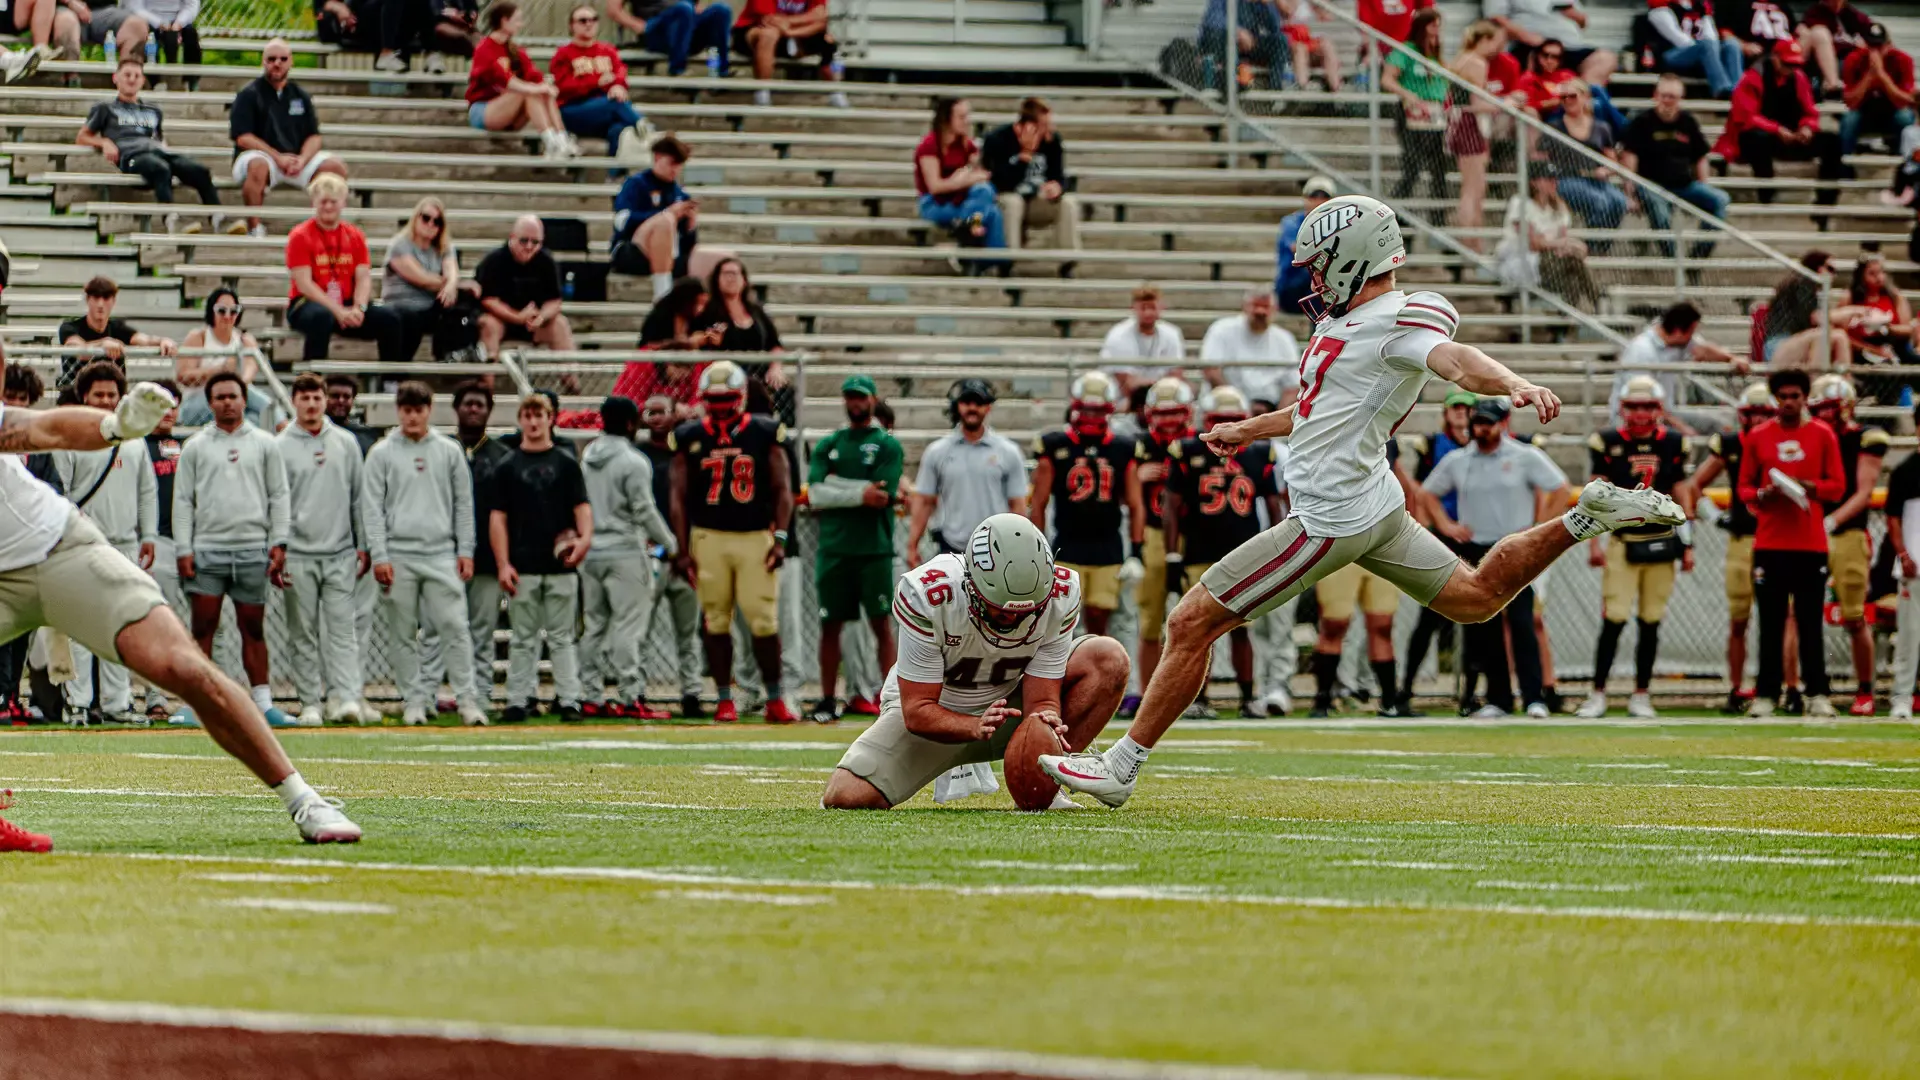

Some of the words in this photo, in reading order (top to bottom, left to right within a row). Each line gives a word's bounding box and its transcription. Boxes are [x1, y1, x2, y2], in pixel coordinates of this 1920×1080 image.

[1311, 204, 1358, 248] IUP
[702, 455, 755, 505] 78
[1066, 463, 1114, 502] 91
[1199, 474, 1256, 517] 50
[1630, 462, 1659, 490] 7
[971, 526, 995, 572] IUP
[919, 568, 954, 608] 46
